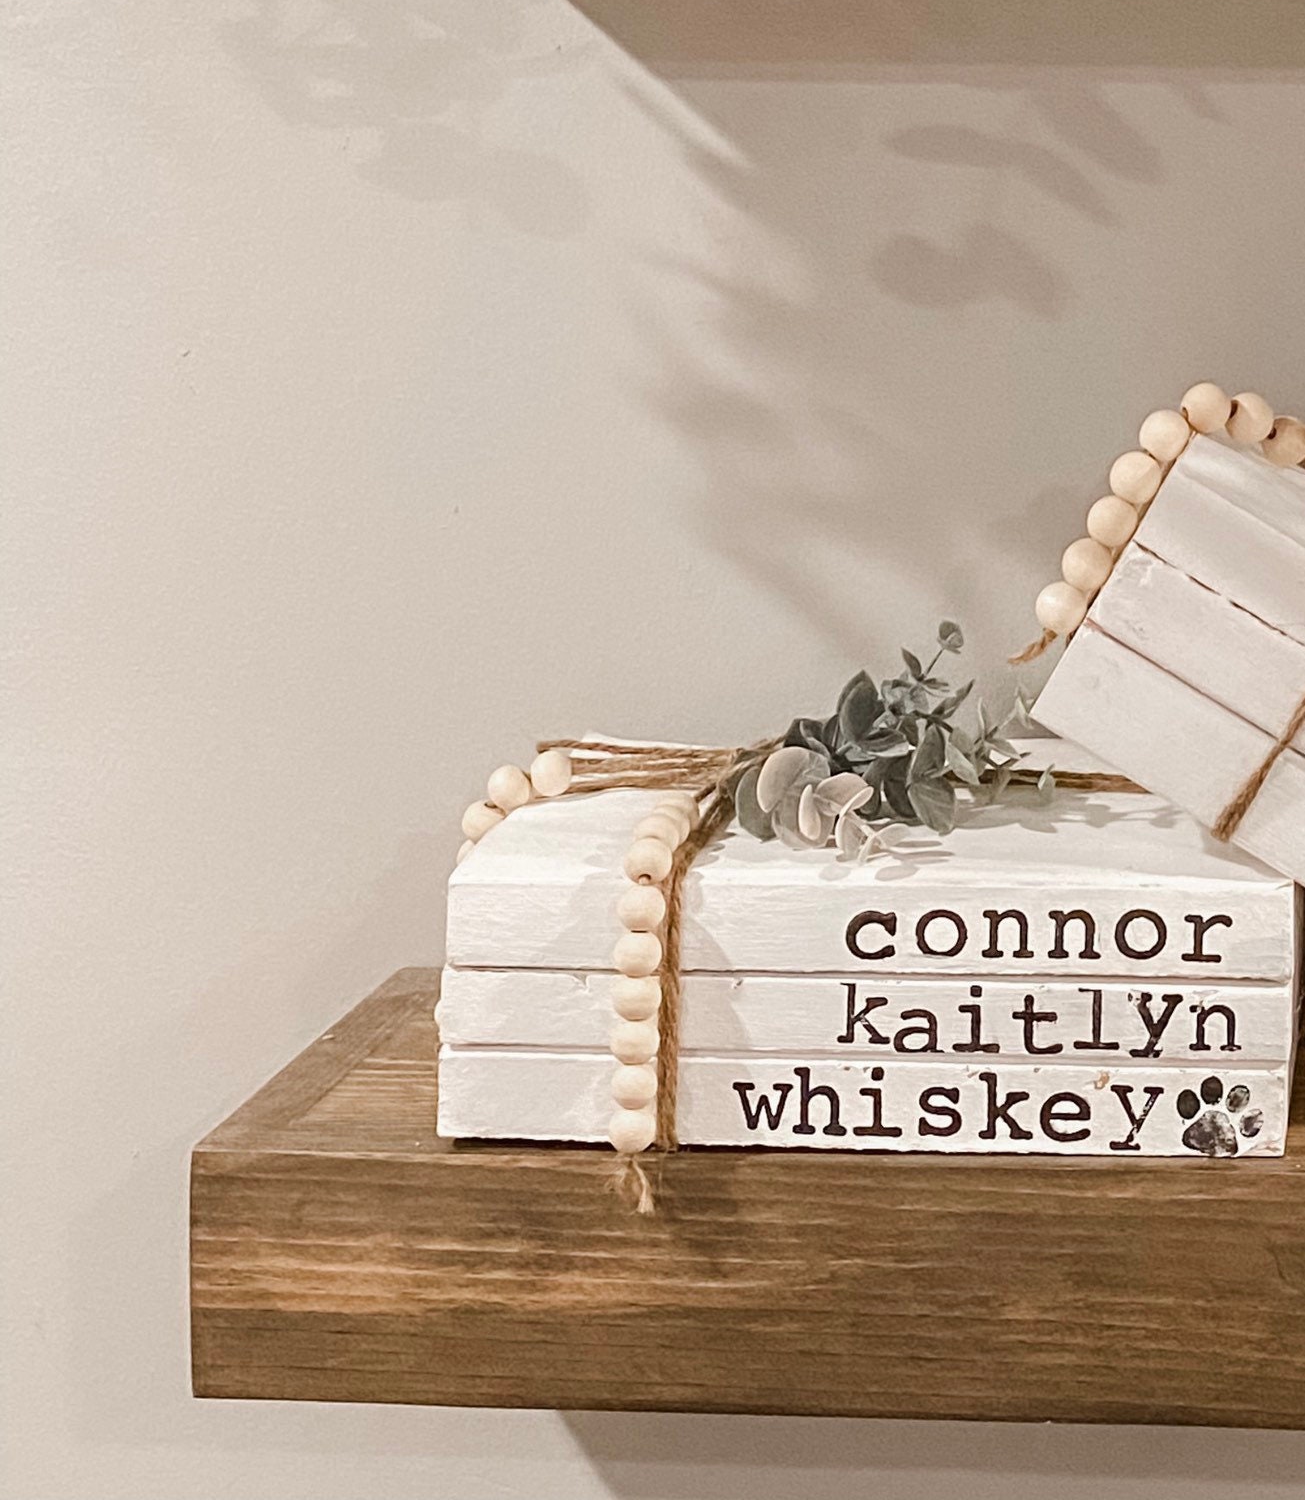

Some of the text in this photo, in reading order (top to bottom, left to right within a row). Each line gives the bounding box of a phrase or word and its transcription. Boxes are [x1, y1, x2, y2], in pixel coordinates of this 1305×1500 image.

[845, 909, 1233, 963] connor
[837, 982, 1242, 1058] kaitlyn
[732, 1067, 1165, 1151] whiskey
